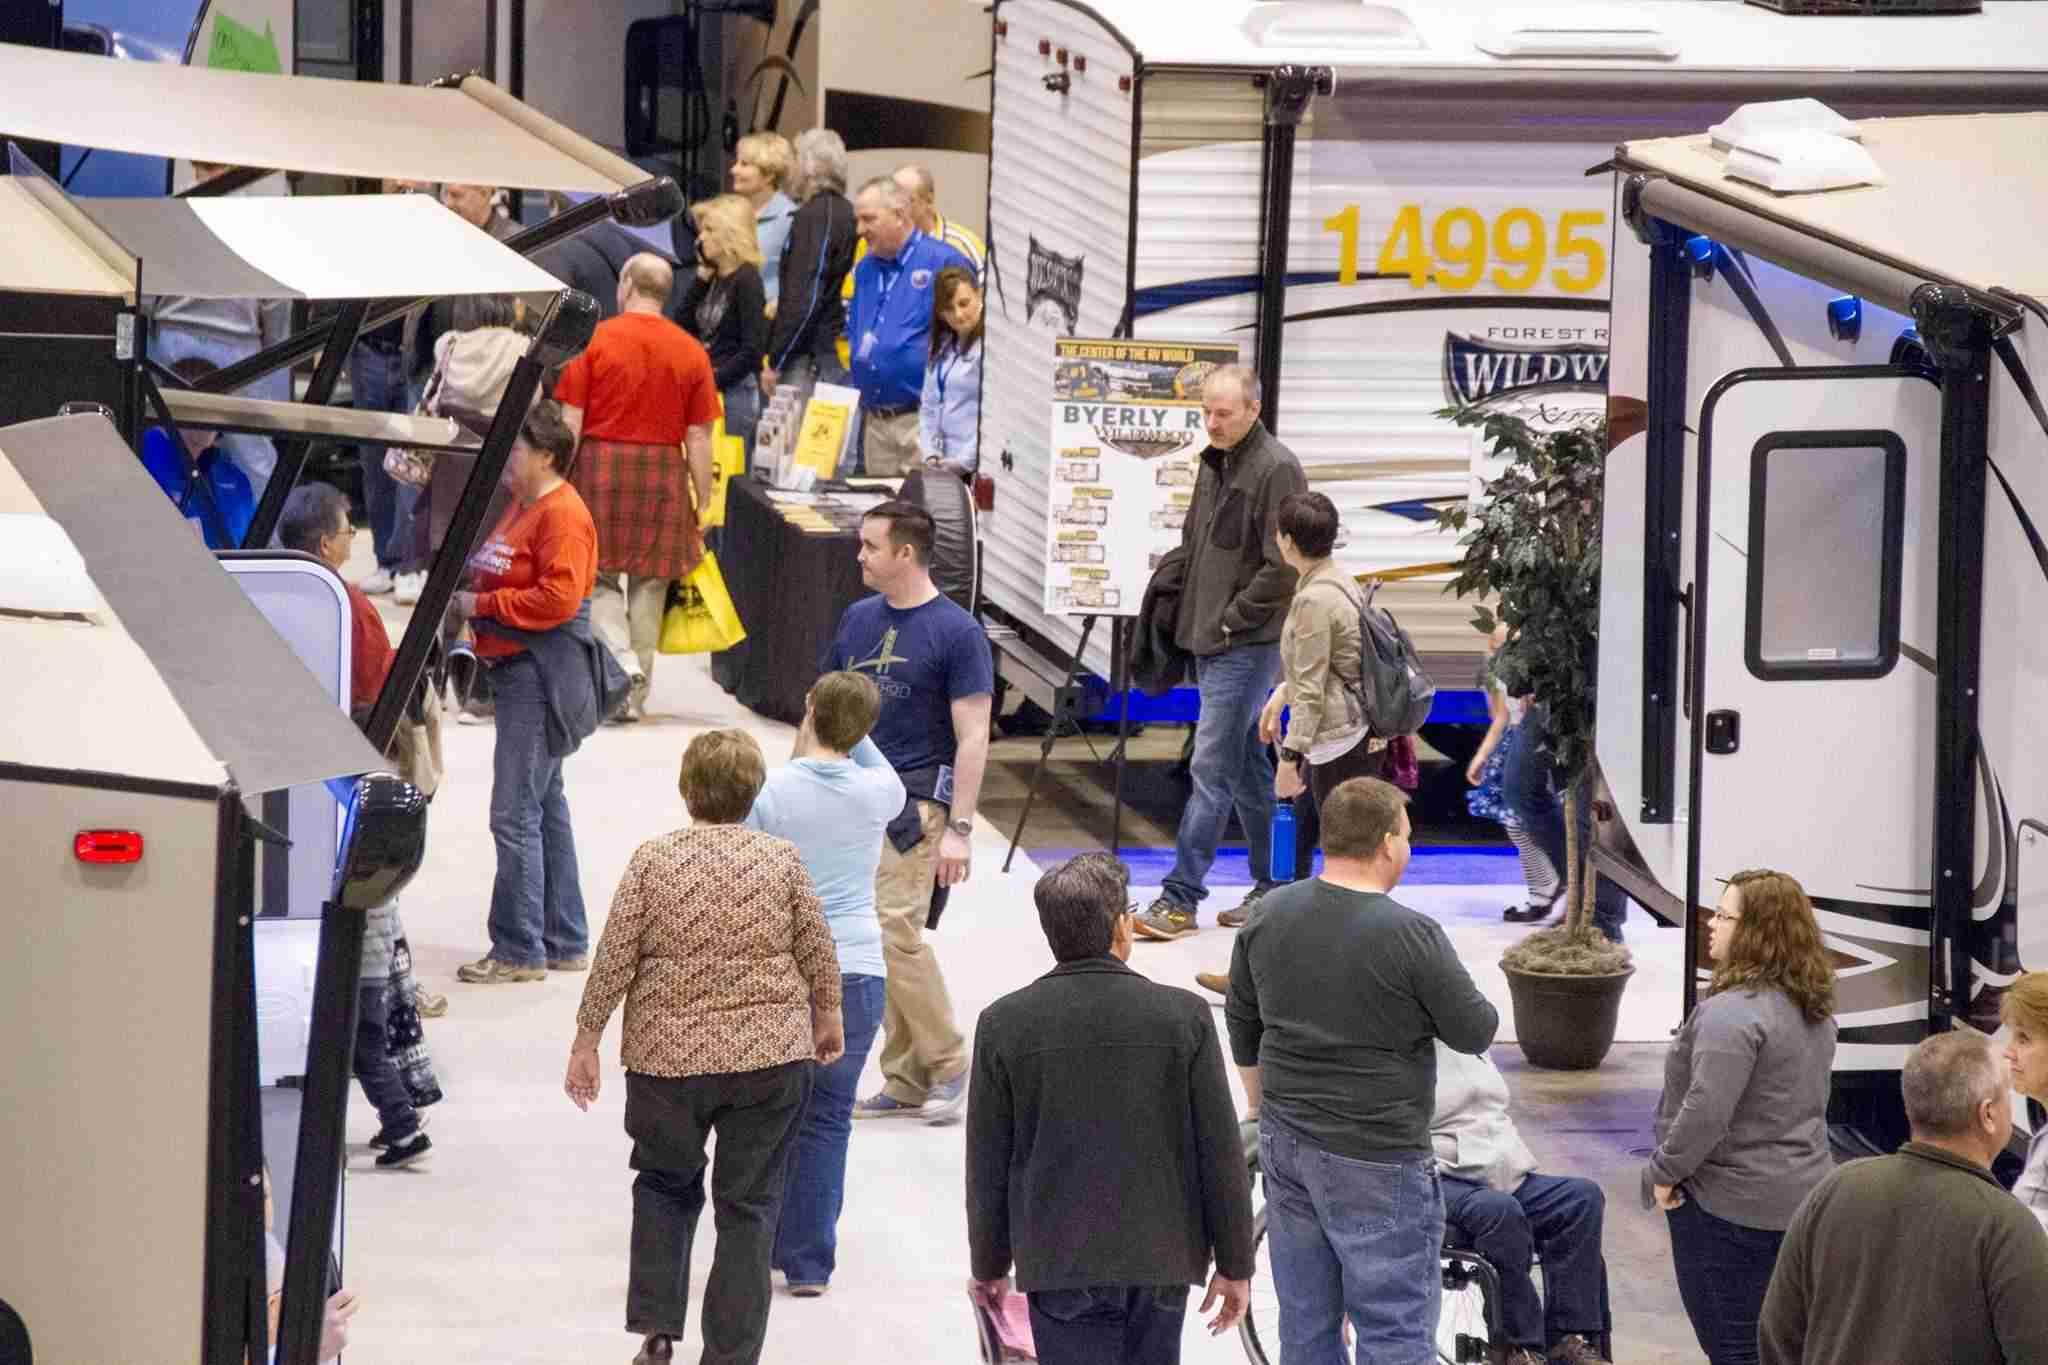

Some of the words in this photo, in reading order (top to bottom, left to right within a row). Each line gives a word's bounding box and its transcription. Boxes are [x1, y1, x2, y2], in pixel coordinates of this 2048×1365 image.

[1322, 203, 1606, 293] 14995
[1488, 327, 1586, 340] FOREST
[1595, 327, 1609, 340] R
[1061, 345, 1077, 357] THE
[1080, 346, 1112, 359] CENTER
[1117, 347, 1128, 359] OF
[1130, 347, 1145, 360] THE
[1463, 352, 1608, 399] WILDW
[1063, 405, 1168, 427] BYERLY
[1185, 410, 1201, 429] R
